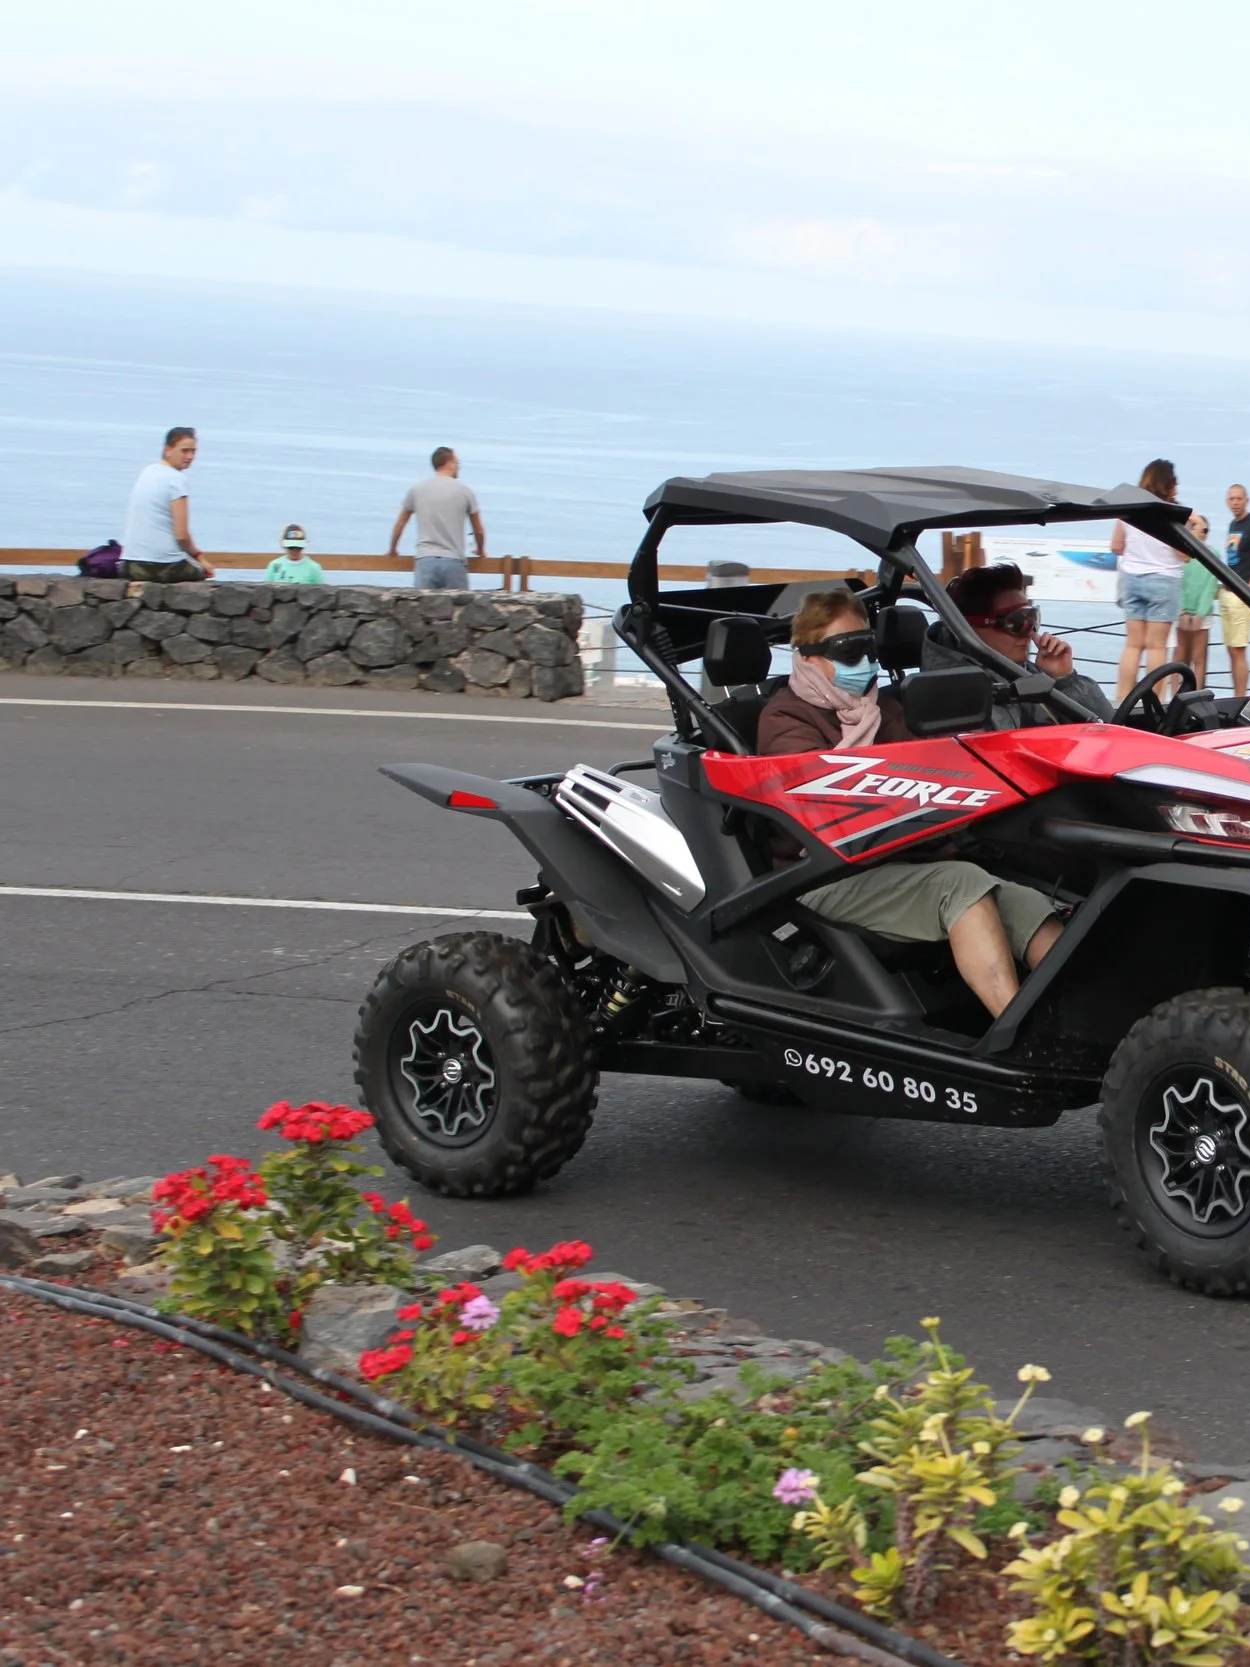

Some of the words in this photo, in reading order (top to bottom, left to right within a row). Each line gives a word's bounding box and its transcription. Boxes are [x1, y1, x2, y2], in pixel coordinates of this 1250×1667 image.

[805, 1054, 853, 1082] 692
[863, 1067, 894, 1092] 60
[903, 1077, 936, 1103] 80
[945, 1087, 978, 1113] 35
